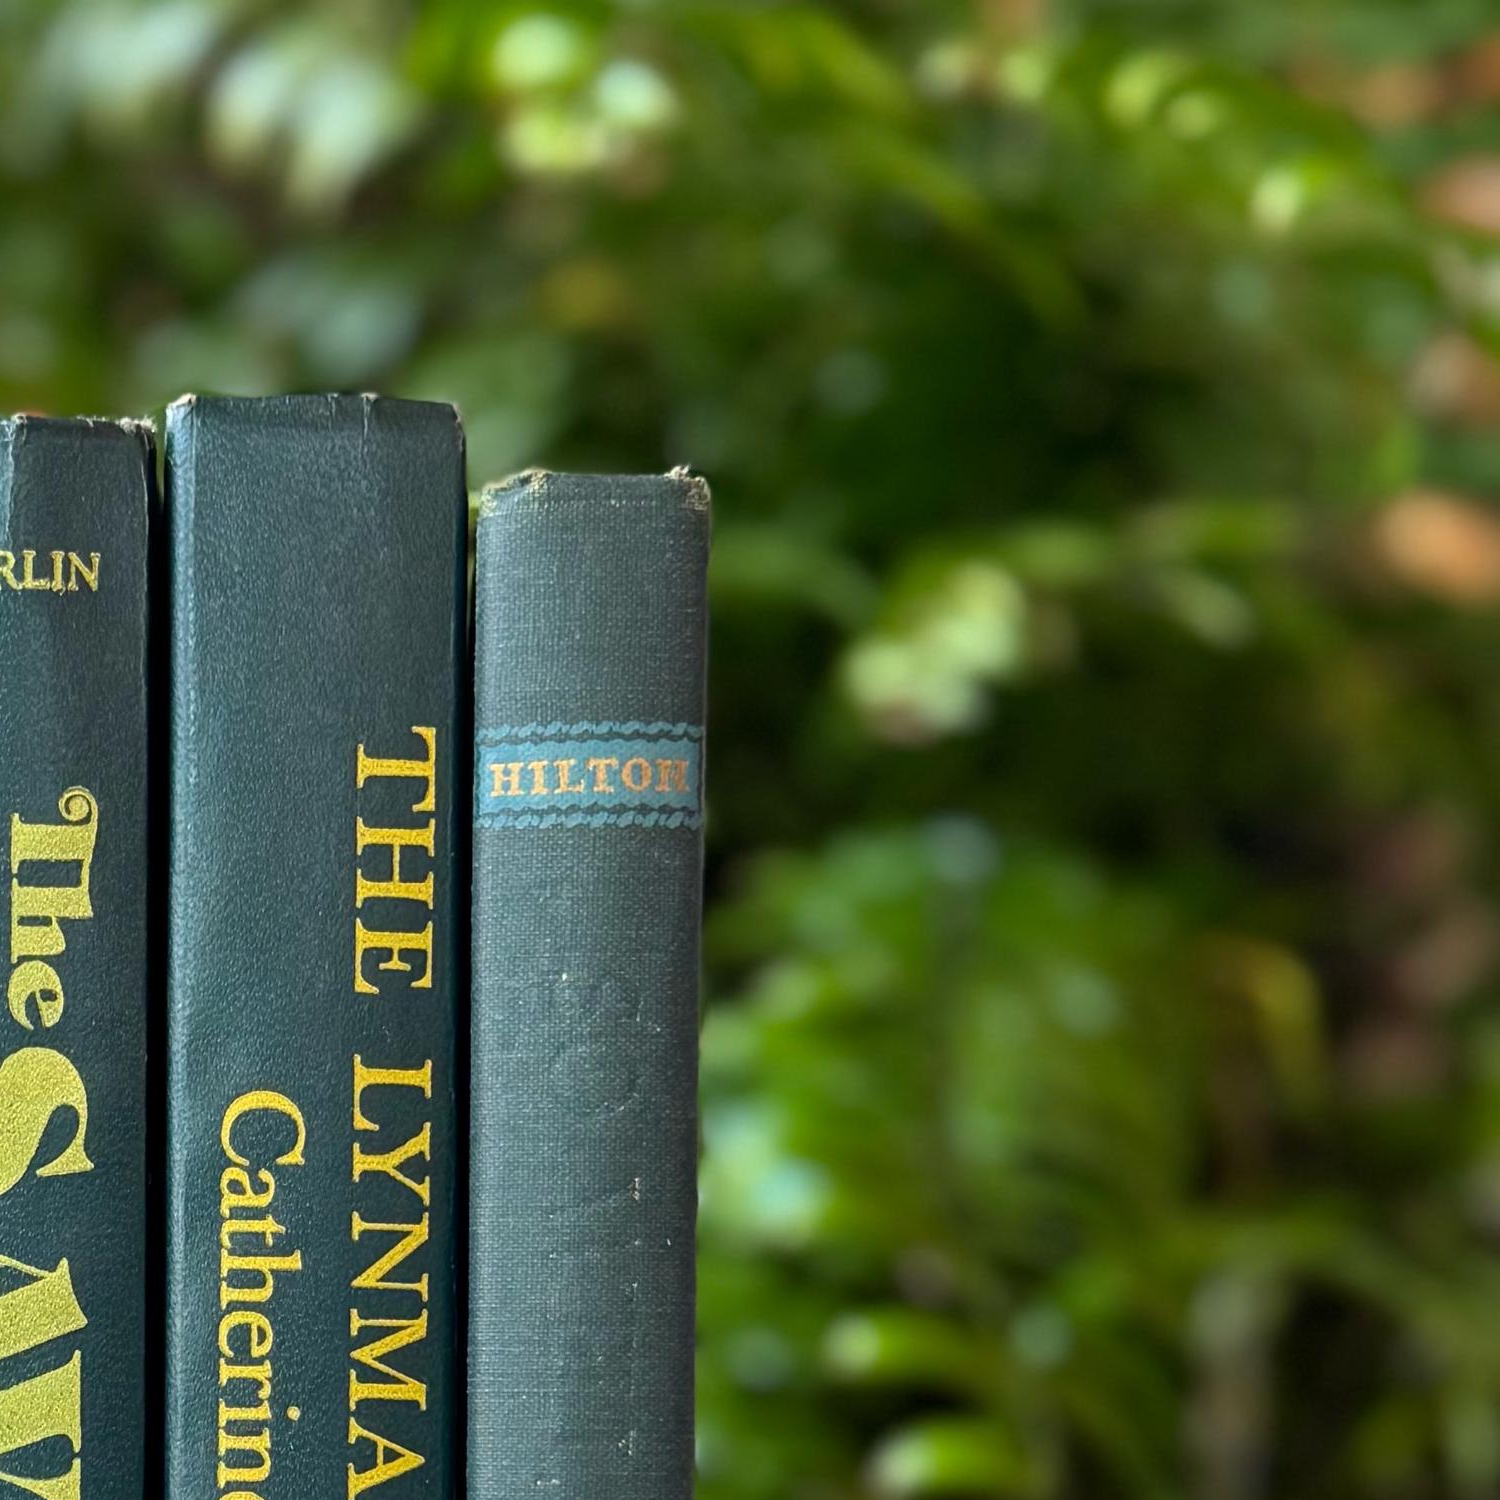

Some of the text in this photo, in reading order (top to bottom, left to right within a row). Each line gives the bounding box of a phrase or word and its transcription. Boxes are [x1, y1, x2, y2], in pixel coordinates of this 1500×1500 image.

[353, 725, 437, 995] THE
[488, 756, 691, 798] HILTON
[5, 785, 99, 1030] The
